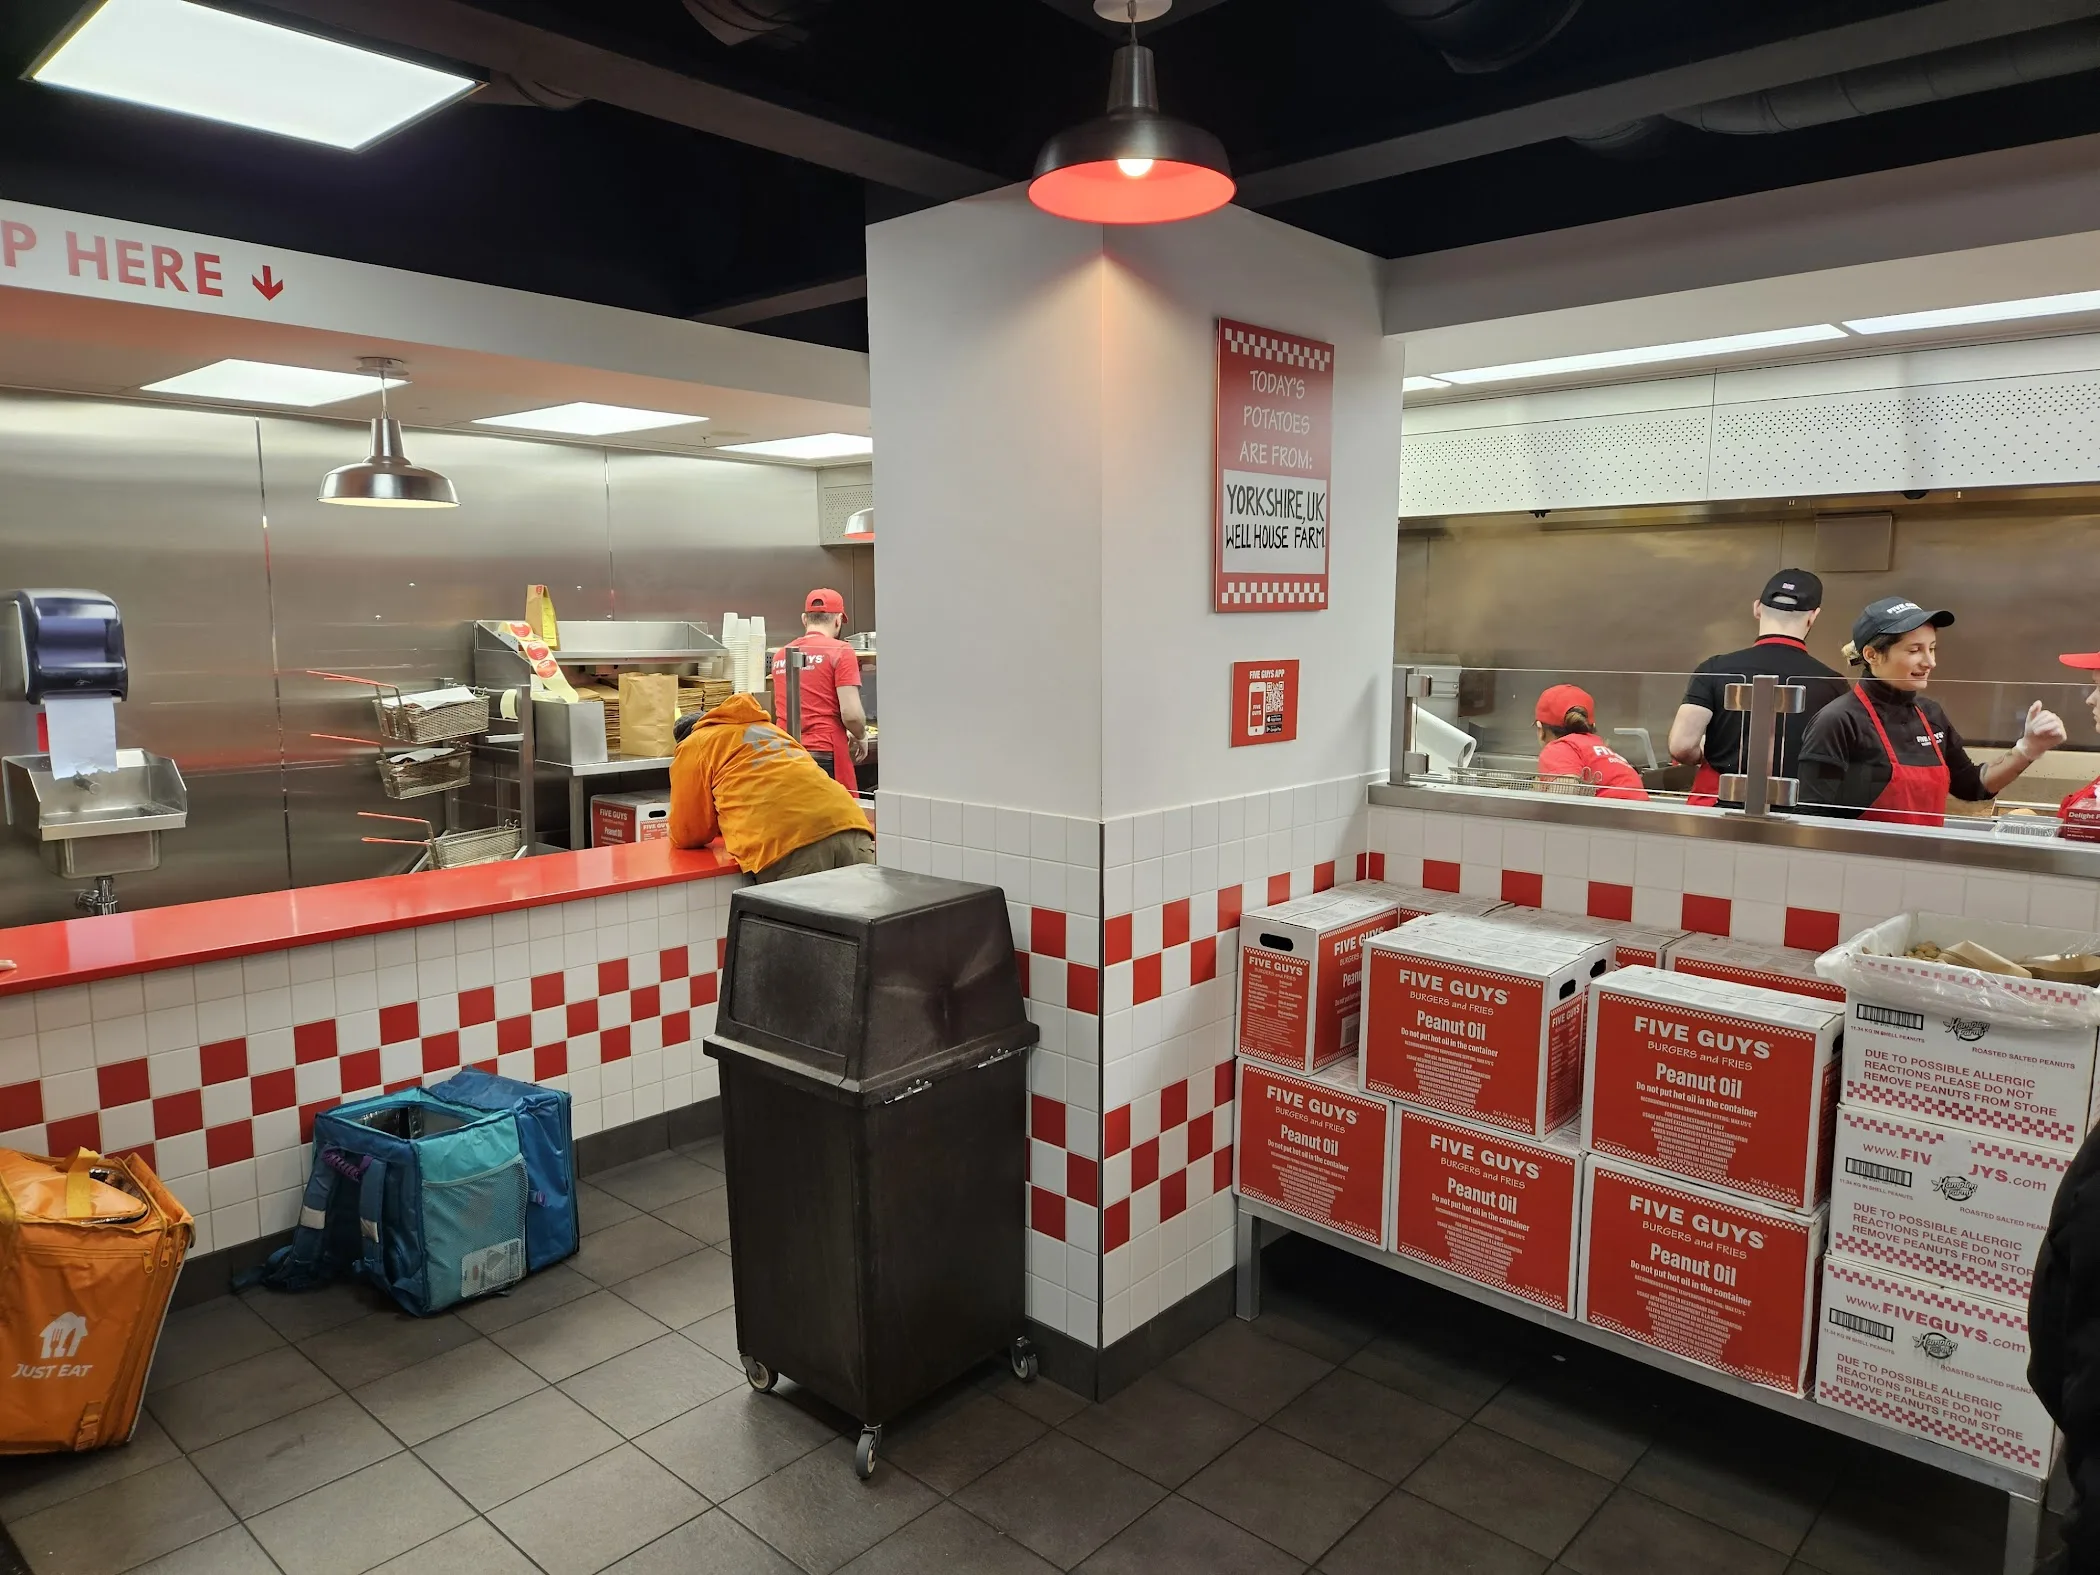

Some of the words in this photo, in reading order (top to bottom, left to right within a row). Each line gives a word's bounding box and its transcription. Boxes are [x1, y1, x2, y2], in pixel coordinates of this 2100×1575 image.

[66, 230, 223, 297] HERE
[1250, 370, 1305, 399] TODAY'S
[1244, 405, 1310, 435] POTATOES
[1240, 441, 1267, 464] ARE
[1272, 445, 1312, 469] FROM:
[1226, 523, 1250, 549] WELL
[1254, 524, 1288, 549] HOUSE
[1295, 526, 1325, 549] FARM
[1250, 671, 1260, 679] FIVE
[1261, 670, 1274, 678] GUYS
[1275, 669, 1284, 677] APP
[600, 809, 611, 817] FIVE
[613, 811, 627, 820] GUYS
[1334, 936, 1356, 956] FIVE
[1249, 956, 1271, 968] FIVE
[1274, 962, 1302, 976] GUYS
[1400, 969, 1443, 991] FIVE
[1450, 980, 1508, 1005] GUYS
[1410, 991, 1449, 1006] BURGERS
[1452, 1002, 1467, 1010] and
[1469, 1004, 1494, 1015] FRIES
[1417, 1010, 1465, 1036] Peanut
[1468, 1022, 1486, 1040] Oil
[1552, 1014, 1566, 1028] FIVE
[1567, 1004, 1580, 1020] GUYS
[1635, 1016, 1689, 1042] FIVE
[1698, 1030, 1770, 1059] GUYS
[1648, 1041, 1697, 1058] BURGERS
[1700, 1054, 1718, 1063] and
[1722, 1057, 1752, 1071] FRIES
[1865, 1048, 1889, 1060] DUE
[1891, 1054, 1907, 1063] TO
[1911, 1058, 1969, 1076] POSSIBLE
[1973, 1070, 2036, 1088] ALLERGIC
[1972, 1047, 2007, 1058] ROASTED
[2009, 1054, 2037, 1063] SALTED
[2039, 1058, 2075, 1069] PEANUTS
[1656, 1062, 1716, 1093] Peanut
[1720, 1077, 1742, 1099] Oil
[1864, 1060, 1931, 1080] REACTIONS
[1935, 1074, 1980, 1090] PLEASE
[1984, 1084, 2003, 1094] DO
[2006, 1088, 2033, 1100] NOT
[1864, 1072, 1912, 1088] REMOVE
[1915, 1083, 1970, 1100] PEANUTS
[1974, 1094, 2010, 1108] FROM
[2014, 1102, 2057, 1116] STORE
[1267, 1085, 1303, 1108] FIVE
[1309, 1099, 1357, 1124] GUYS
[1636, 1081, 1645, 1090] Do
[1647, 1086, 1659, 1094] not
[1660, 1088, 1672, 1097] put
[1673, 1090, 1685, 1100] hot
[1687, 1094, 1696, 1103] oil
[1697, 1097, 1704, 1105] in
[1706, 1098, 1718, 1108] the
[1720, 1103, 1758, 1118] container
[1276, 1106, 1308, 1122] BURGERS
[1310, 1119, 1323, 1127] and
[1325, 1122, 1345, 1134] FRIES
[1281, 1124, 1321, 1151] Peanut
[1323, 1138, 1338, 1156] Oil
[1431, 1134, 1474, 1160] FIVE
[1481, 1150, 1539, 1179] GUYS
[1441, 1157, 1480, 1175] BURGERS
[1483, 1172, 1498, 1181] and
[1500, 1176, 1525, 1189] FRIES
[1448, 1177, 1496, 1208] Peanut
[1499, 1194, 1517, 1214] Oil
[1630, 1195, 1684, 1225] FIVE
[1692, 1214, 1764, 1249] GUYS
[1853, 1202, 1877, 1214] DUE
[1880, 1208, 1895, 1219] TO
[1900, 1214, 1957, 1235] POSSIBLE
[1961, 1230, 2022, 1251] ALLERGIC
[1960, 1207, 1995, 1220] ROASTED
[1996, 1214, 2024, 1226] SALTED
[2027, 1221, 2048, 1232] PEAN
[1643, 1221, 1691, 1242] BURGERS
[1694, 1239, 1713, 1250] and
[1716, 1243, 1747, 1259] FRIES
[1853, 1214, 1919, 1237] REACTIONS
[1923, 1232, 1968, 1250] PLEASE
[1972, 1244, 1990, 1255] DO
[1994, 1249, 2020, 1263] NOT
[1853, 1225, 1900, 1243] REMOVE
[1904, 1238, 1958, 1258] PEANUTS
[1962, 1254, 1997, 1269] FROM
[1631, 1260, 1640, 1269] Do
[1641, 1266, 1653, 1274] not
[1654, 1268, 1666, 1279] put
[1668, 1271, 1680, 1282] hot
[1681, 1276, 1690, 1287] oil
[1692, 1280, 1699, 1289] in
[1700, 1282, 1713, 1293] the
[1714, 1288, 1752, 1306] container
[1650, 1243, 1710, 1278] Peanut
[1714, 1263, 1736, 1287] Oil
[1846, 1295, 2026, 1353] www.FIVEGUYS.com
[11, 1364, 57, 1378] JUST
[57, 1364, 94, 1377] EAT
[1838, 1353, 1859, 1366] DUE
[1863, 1361, 1878, 1373] TO
[1881, 1368, 1938, 1391] POSSIBLE
[1942, 1387, 2002, 1411] ALLERGIC
[1941, 1364, 1975, 1379] ROASTED
[1977, 1374, 2004, 1387] SALTED
[1836, 1375, 1882, 1396] REMOVE
[1886, 1391, 1939, 1415] PEANUTS
[1943, 1409, 1977, 1428] FROM
[1982, 1421, 2023, 1440] STORE
[1837, 1364, 1900, 1391] REACTIONS
[1905, 1386, 1948, 1406] PLEASE
[1953, 1401, 1970, 1413] DO
[1974, 1408, 2000, 1422] NOT
